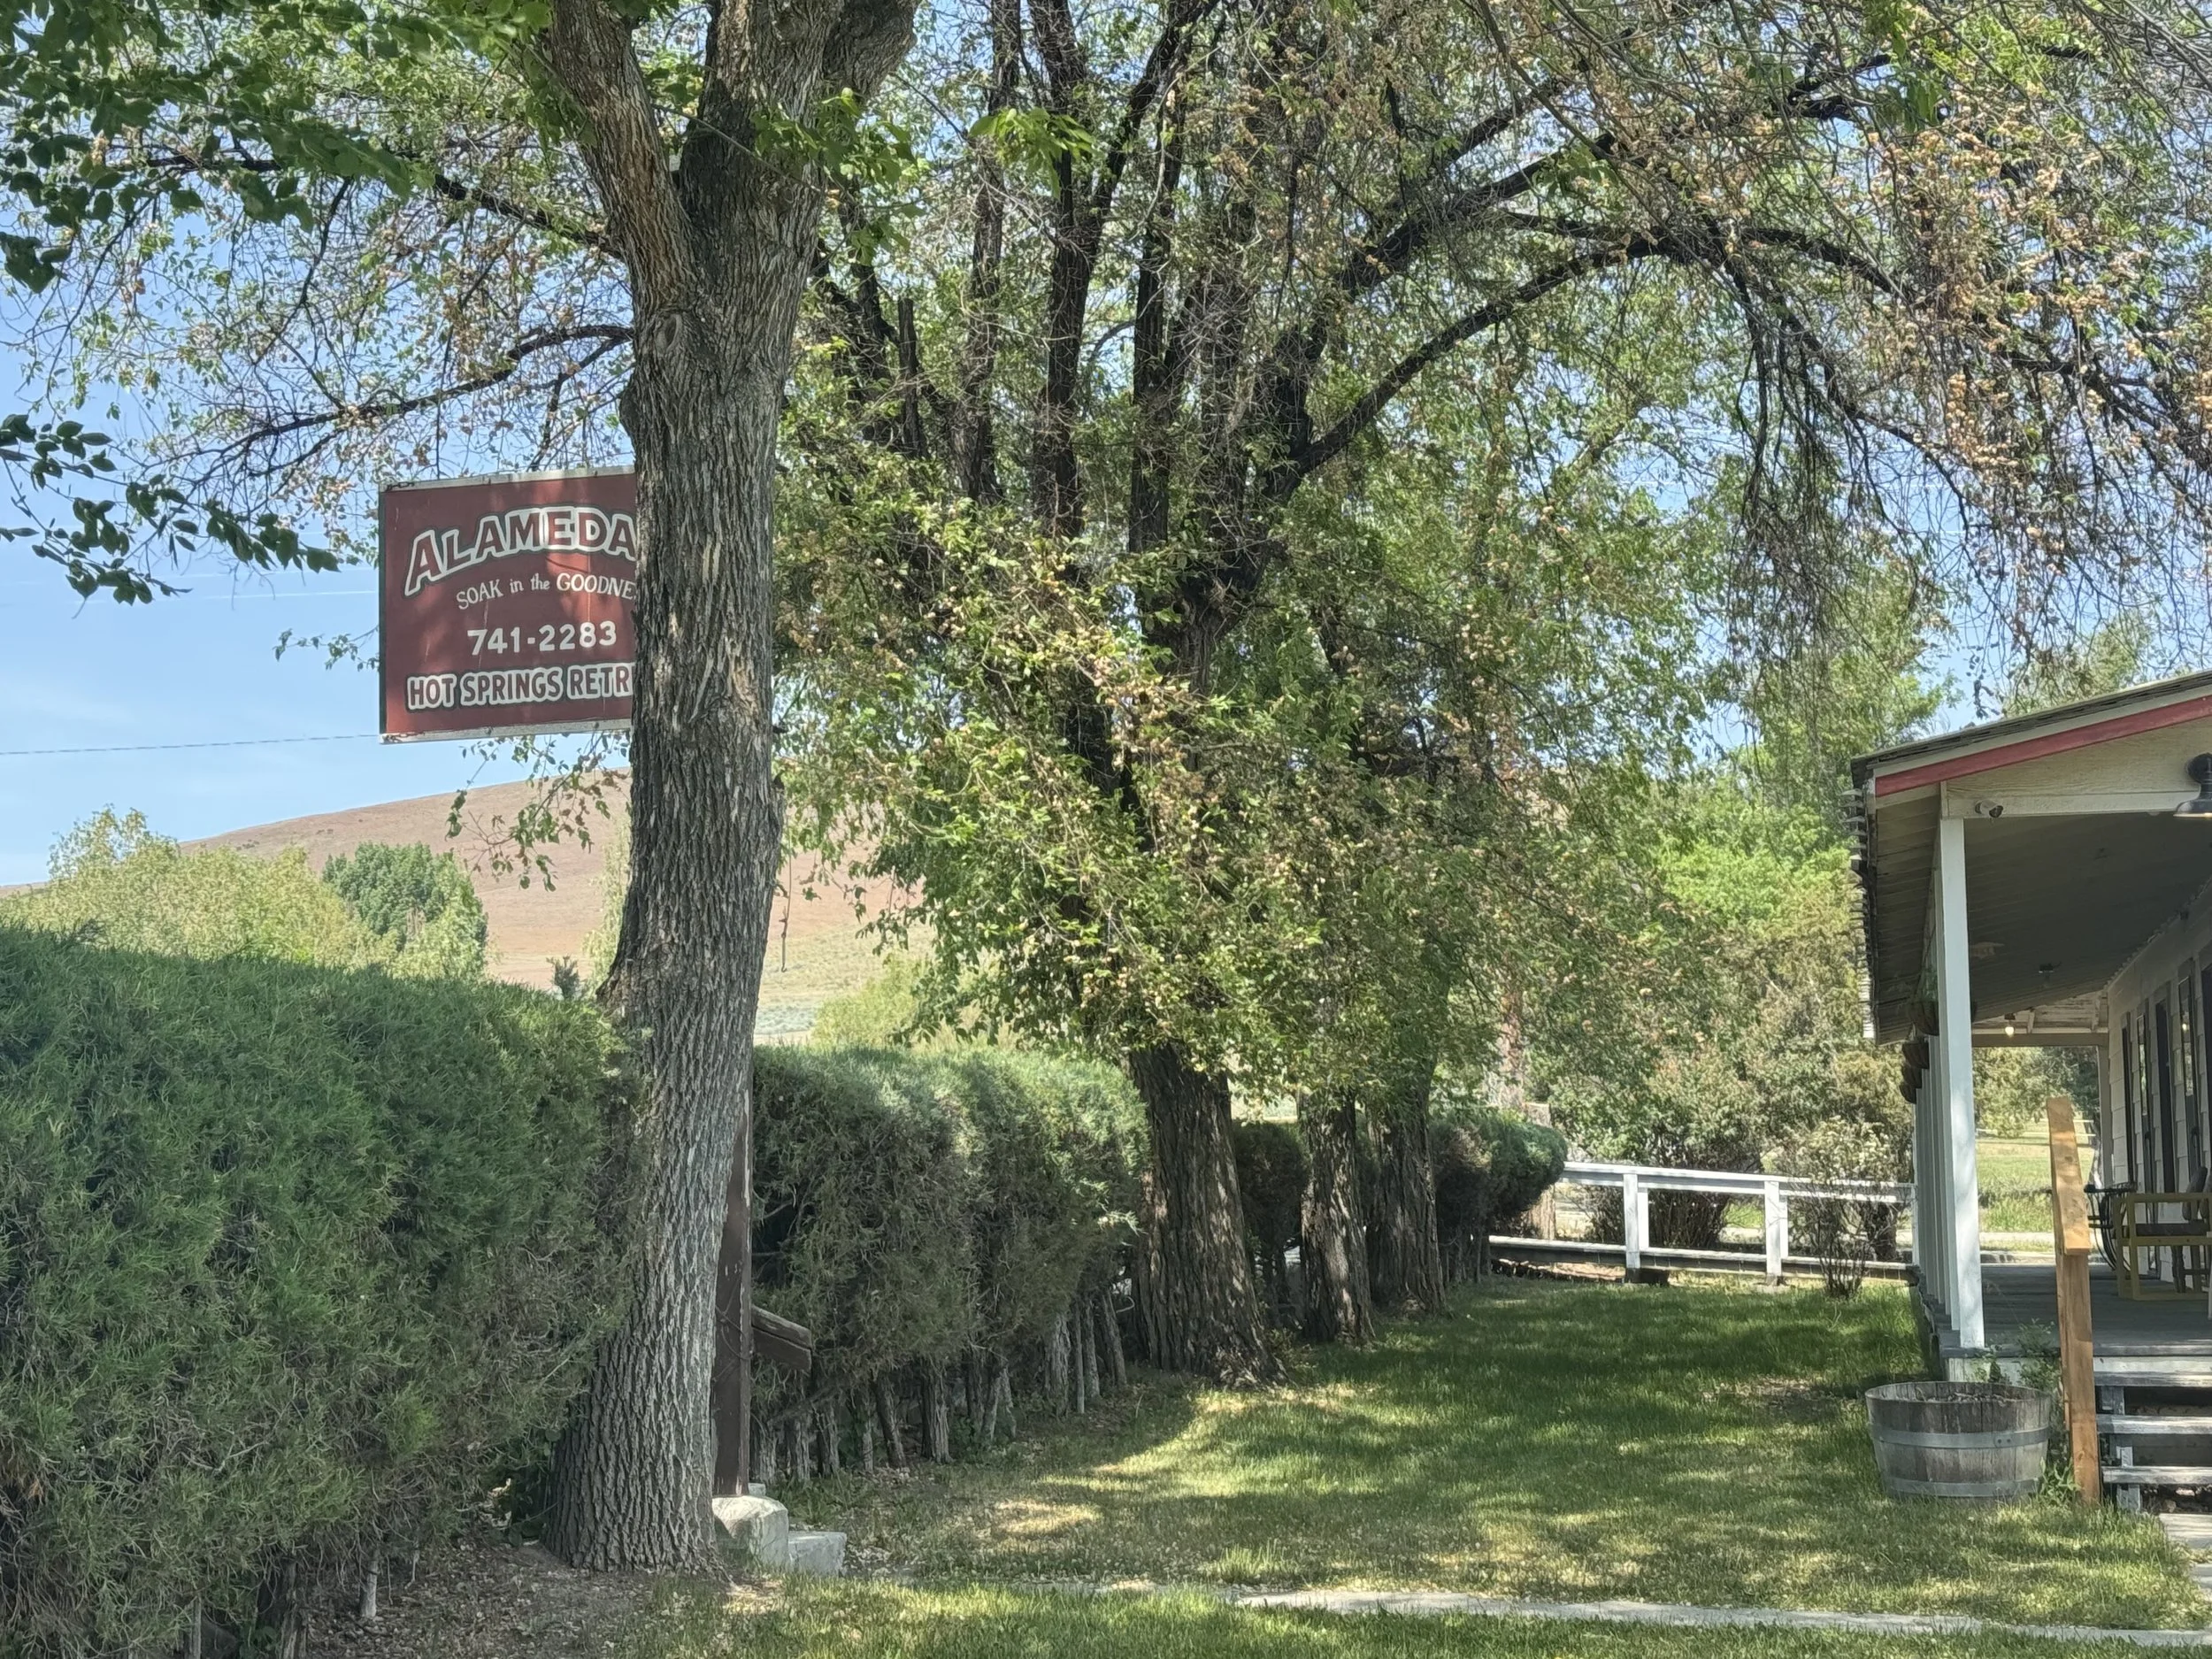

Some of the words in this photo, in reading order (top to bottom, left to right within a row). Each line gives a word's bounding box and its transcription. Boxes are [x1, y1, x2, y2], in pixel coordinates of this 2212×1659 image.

[404, 506, 636, 596] ALAMEDA
[456, 578, 503, 610] SOAK
[510, 577, 525, 593] in
[531, 572, 550, 590] the
[557, 572, 636, 601] GOODNE
[467, 620, 617, 656] 741-2283
[407, 673, 457, 710] HOT
[460, 667, 564, 706] SPRINGS
[567, 663, 635, 699] RETR
